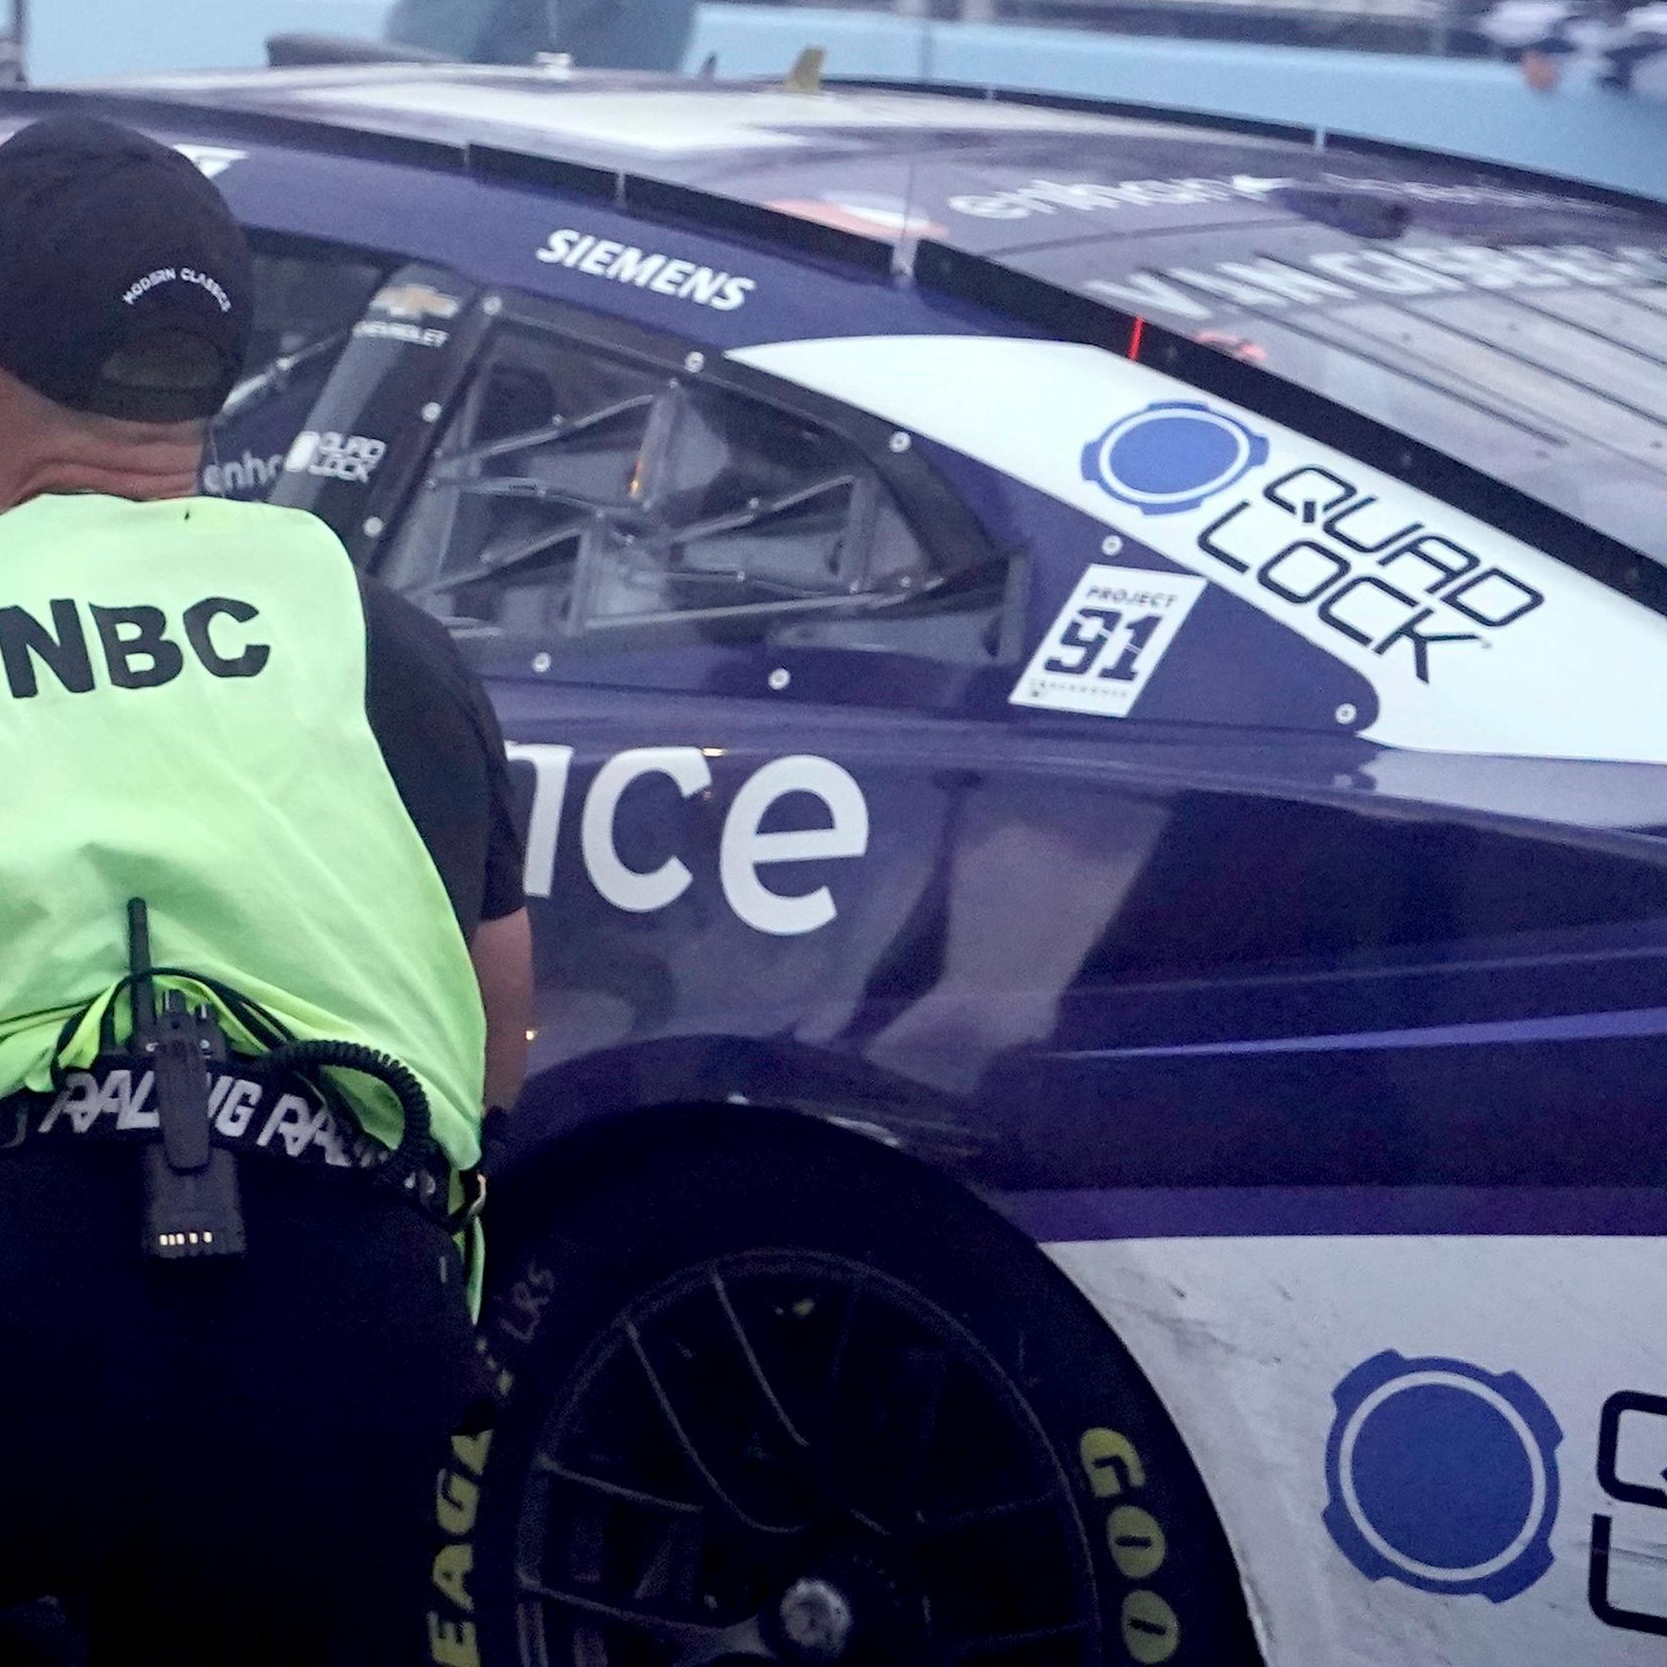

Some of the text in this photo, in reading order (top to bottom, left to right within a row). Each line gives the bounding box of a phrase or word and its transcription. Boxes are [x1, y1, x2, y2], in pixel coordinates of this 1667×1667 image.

[536, 228, 755, 311] SIEMENS
[1082, 262, 1359, 321] VAN
[1263, 463, 1546, 629] QUAD
[1086, 584, 1179, 608] PROJECT
[1197, 502, 1479, 685] LOCK
[1043, 606, 1164, 682] 91
